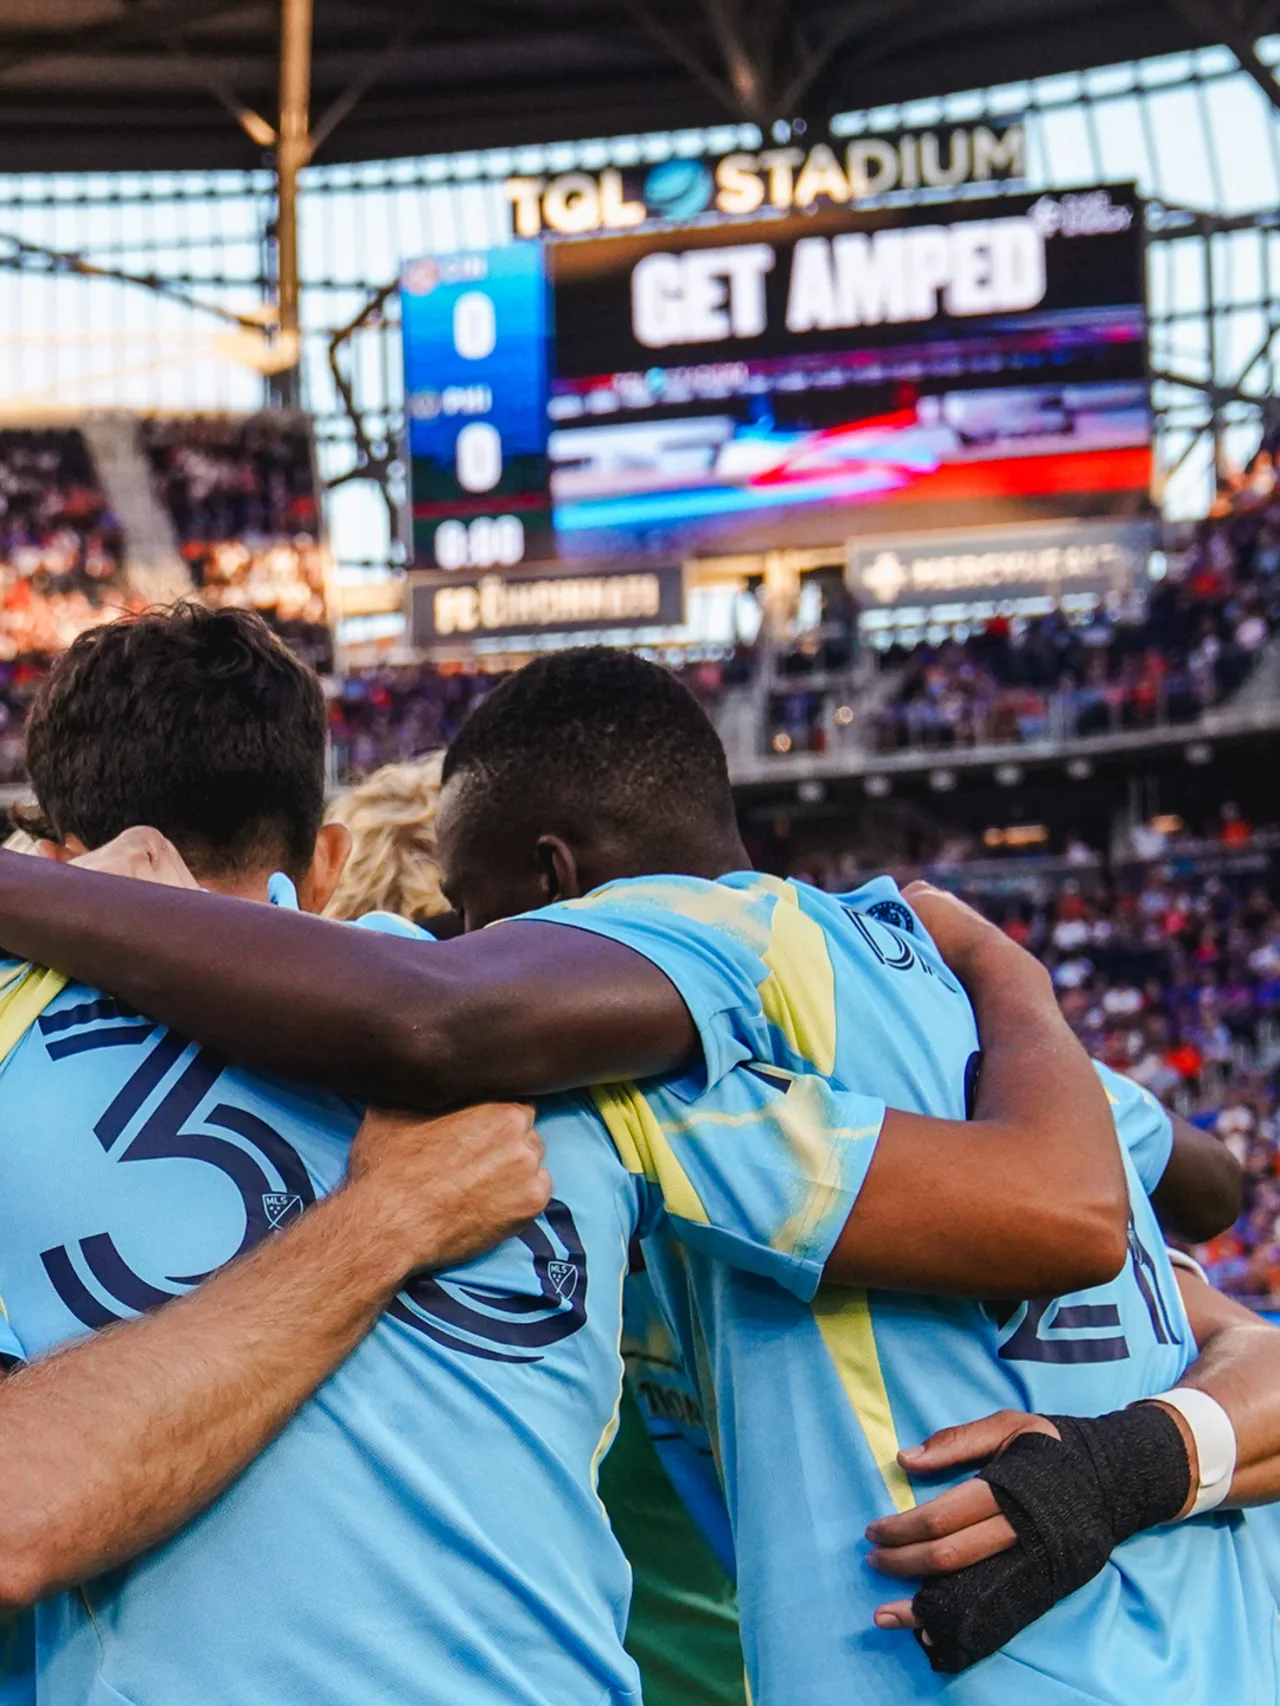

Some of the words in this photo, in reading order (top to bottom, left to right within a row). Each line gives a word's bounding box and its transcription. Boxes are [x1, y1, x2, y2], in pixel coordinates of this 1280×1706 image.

[503, 168, 647, 238] TQL
[716, 126, 1024, 215] STADIUM
[631, 242, 776, 349] GET
[785, 214, 1047, 334] AMPED
[453, 291, 497, 361] 0
[455, 420, 502, 493] 0
[266, 1196, 288, 1206] MLS
[550, 1264, 568, 1274] MLS
